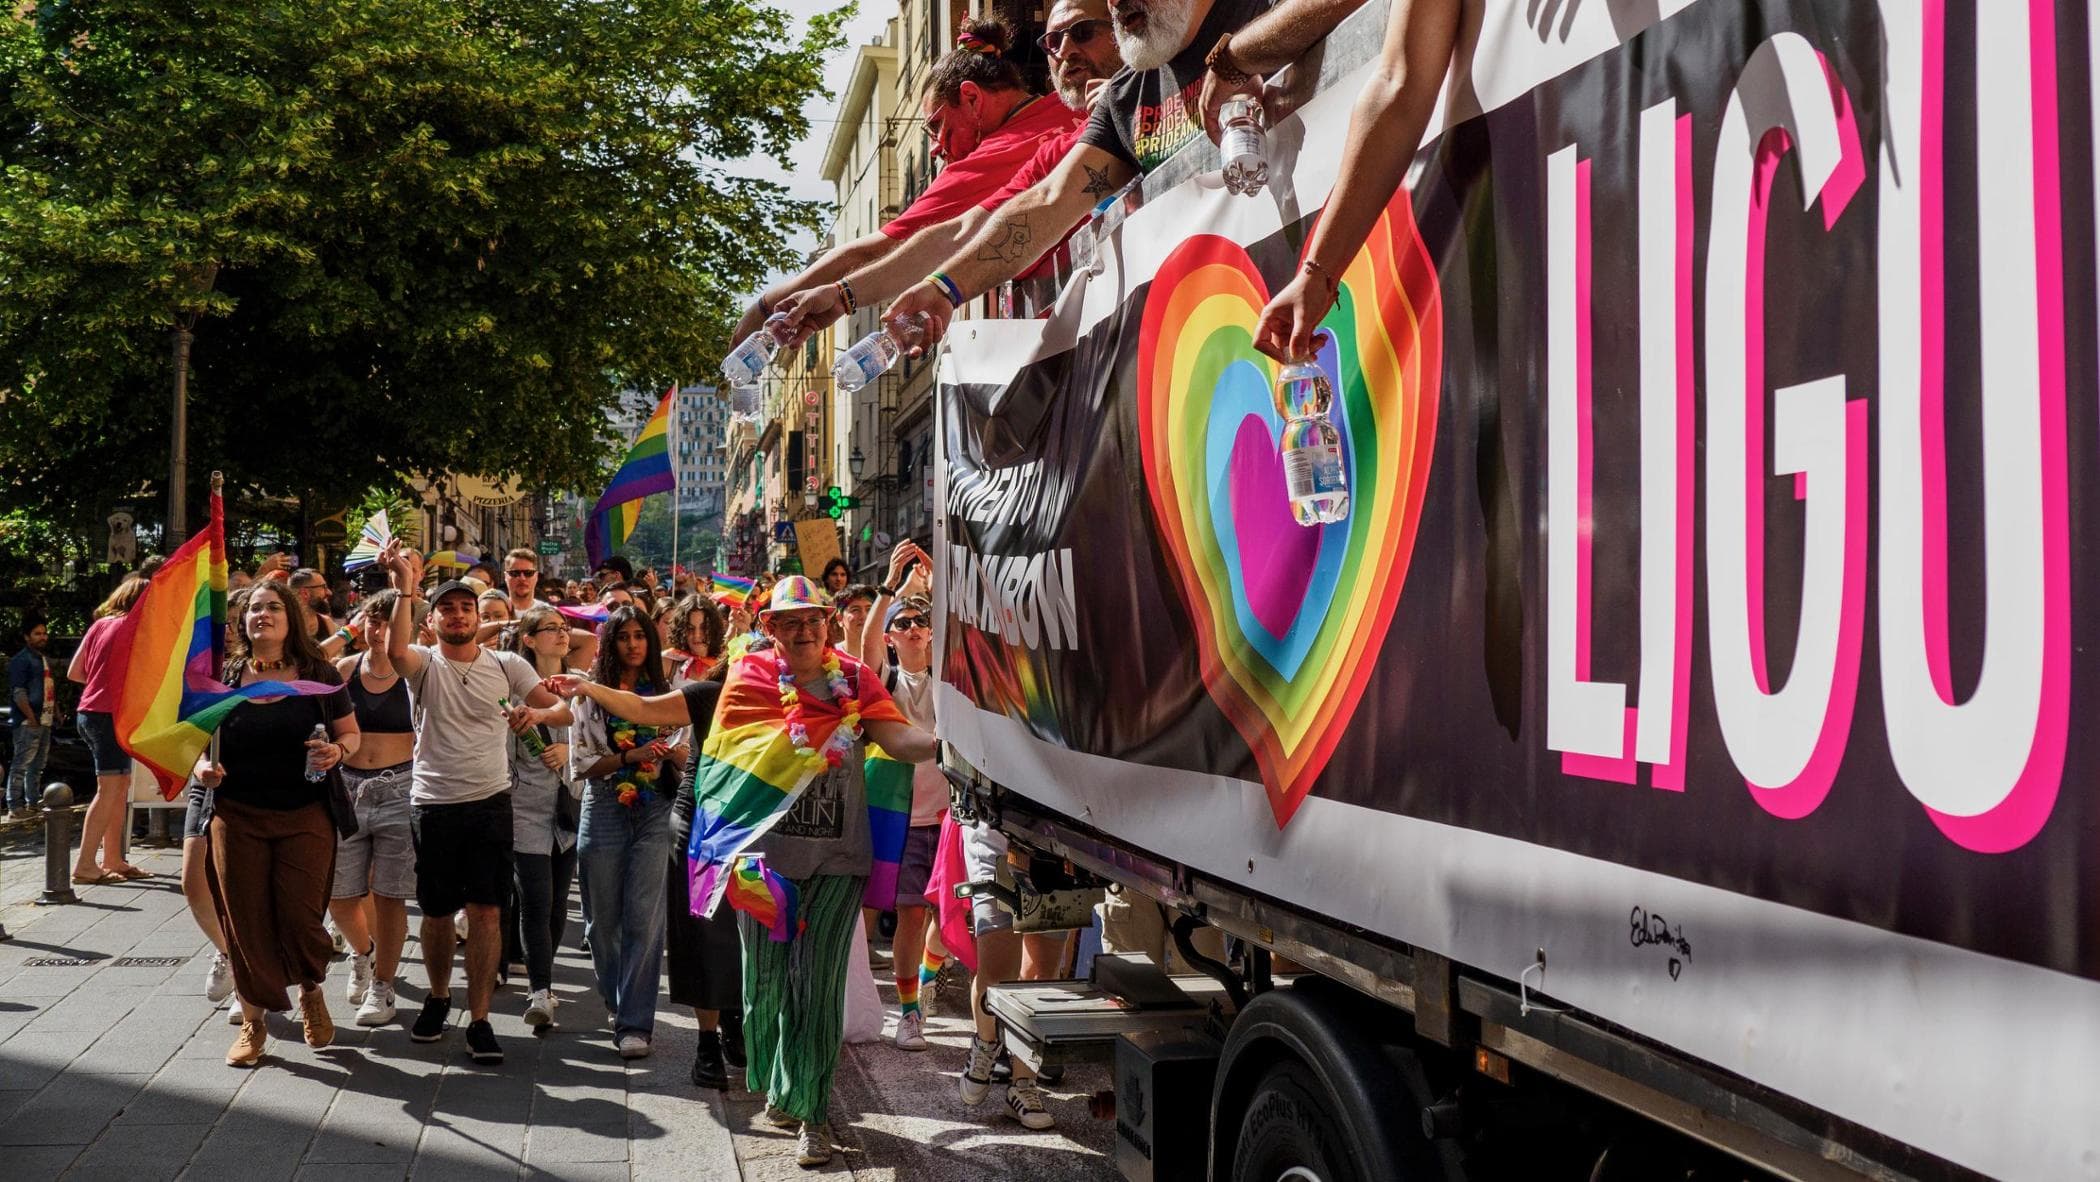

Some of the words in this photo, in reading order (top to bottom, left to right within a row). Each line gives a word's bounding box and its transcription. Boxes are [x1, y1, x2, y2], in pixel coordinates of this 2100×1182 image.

[1548, 0, 2100, 852] LIGU
[473, 495, 515, 505] PIZZERIA
[780, 799, 836, 827] RLIN
